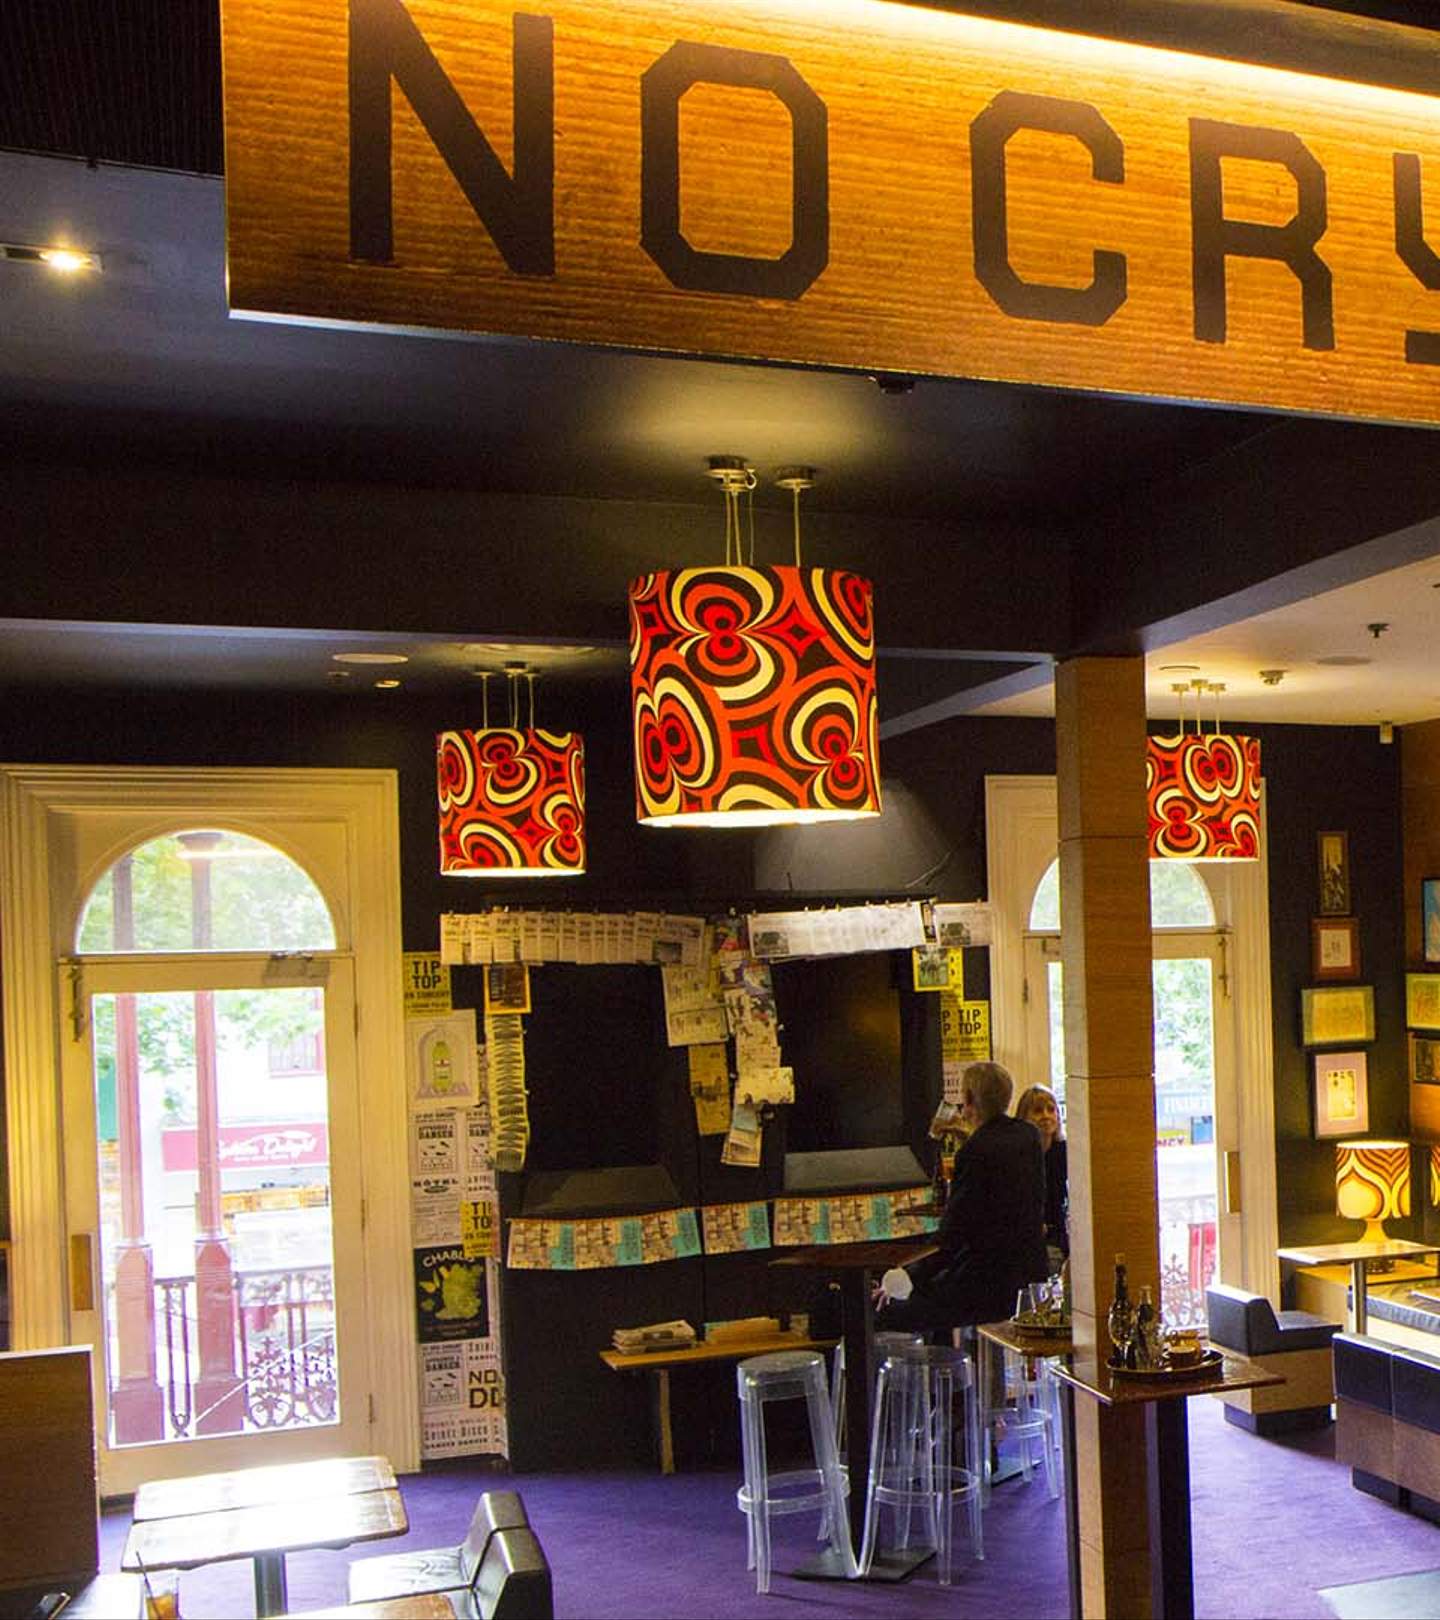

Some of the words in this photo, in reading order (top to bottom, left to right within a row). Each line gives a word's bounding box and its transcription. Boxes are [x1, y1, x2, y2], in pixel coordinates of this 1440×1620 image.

[349, 0, 829, 301] NO
[412, 960, 441, 974] TIP
[412, 975, 442, 989] TOP
[957, 1009, 981, 1021] TIP
[958, 1022, 982, 1035] TOP
